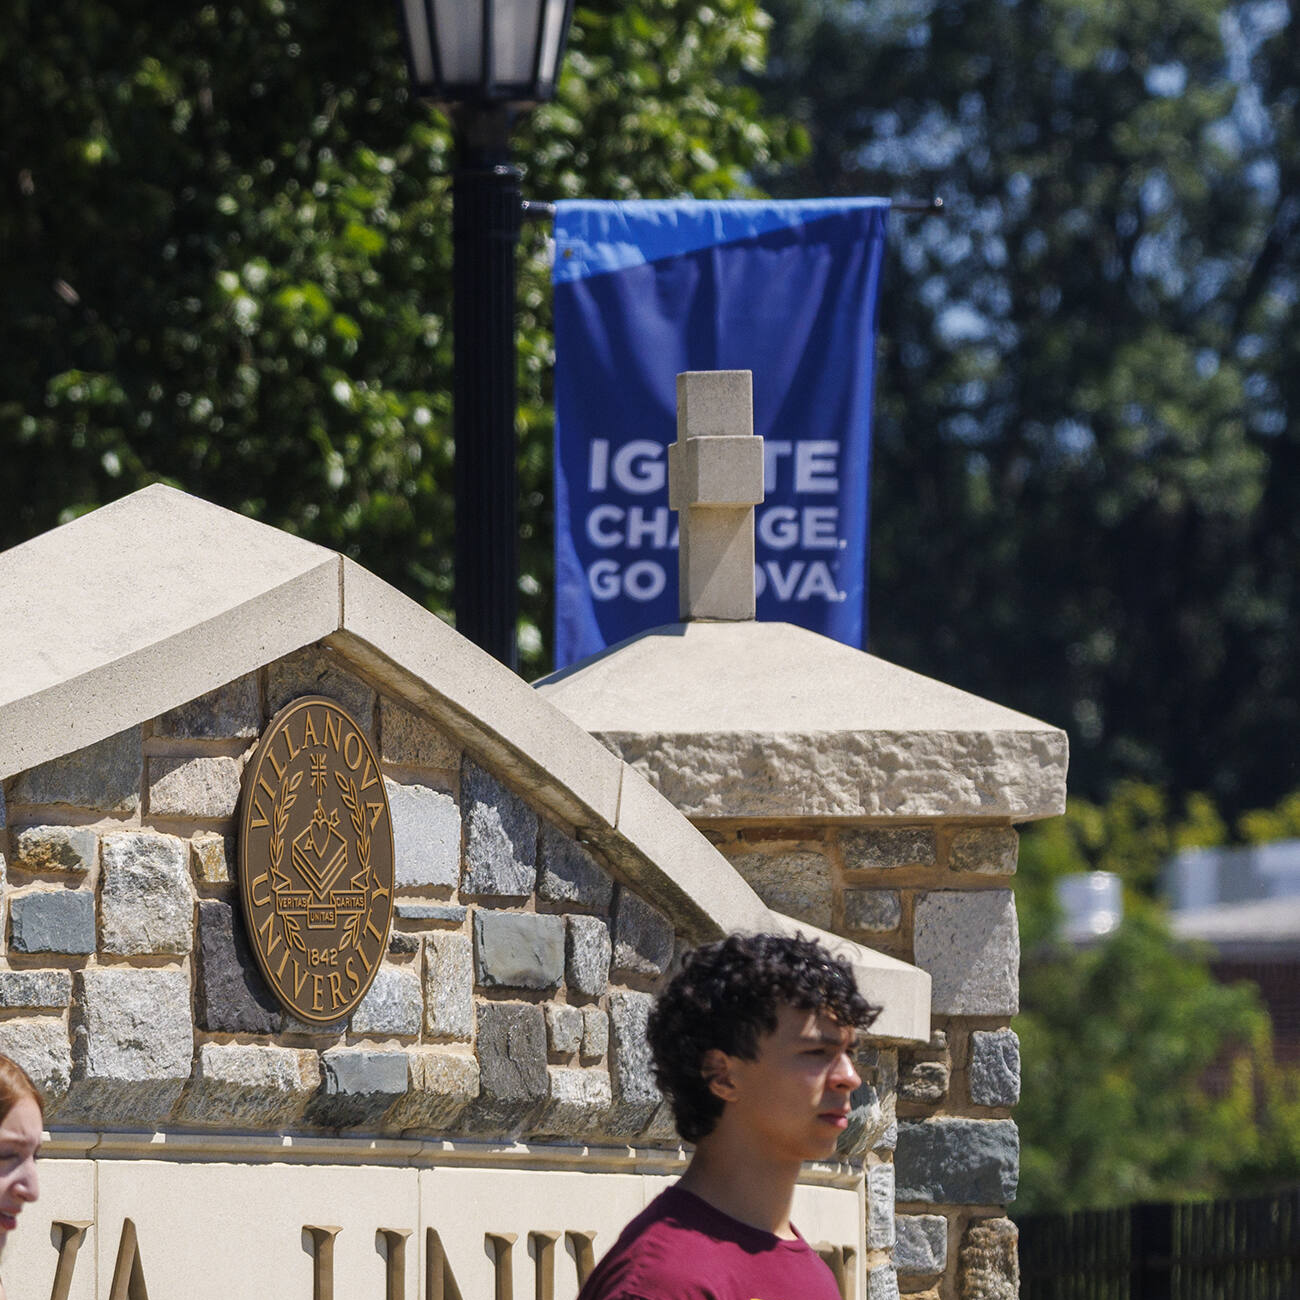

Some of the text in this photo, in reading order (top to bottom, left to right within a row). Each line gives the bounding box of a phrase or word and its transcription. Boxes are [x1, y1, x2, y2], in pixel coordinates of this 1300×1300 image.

[588, 439, 839, 495] IGTE
[586, 506, 847, 550] CHGE.
[588, 559, 666, 601] GO
[251, 710, 385, 833] VILLANOVA
[279, 896, 365, 908] VERITAS CARITAS
[310, 911, 335, 923] UNITAS
[251, 871, 390, 1012] UNIVERSITY
[307, 948, 338, 968] 1842
